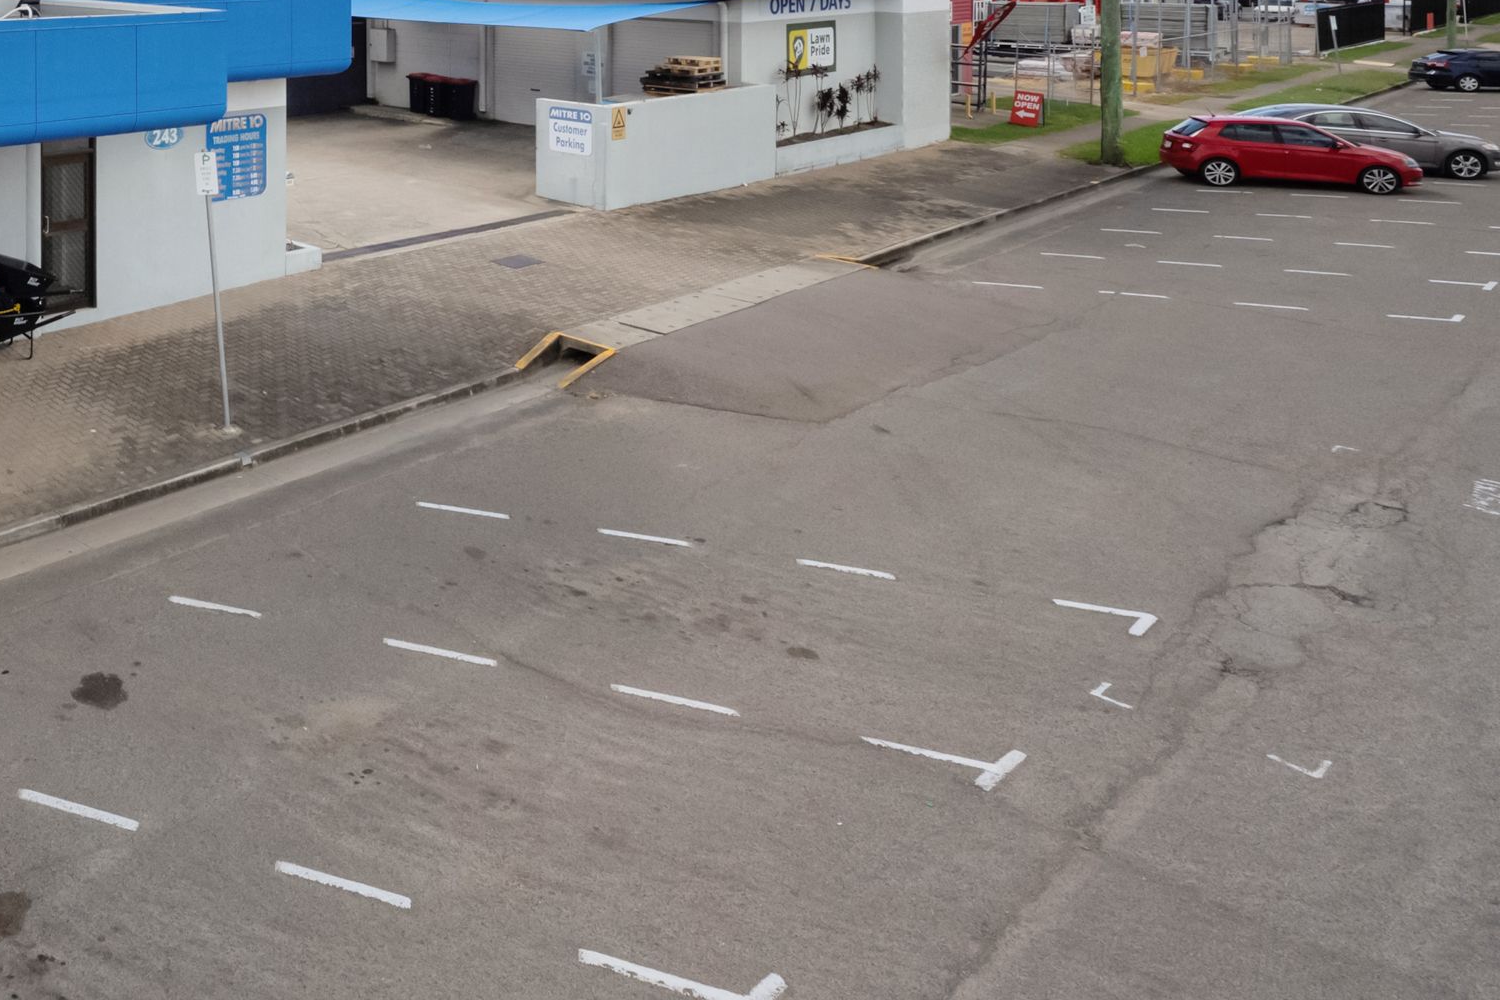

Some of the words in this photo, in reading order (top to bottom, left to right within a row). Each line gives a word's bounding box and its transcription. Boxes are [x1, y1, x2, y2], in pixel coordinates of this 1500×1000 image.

[810, 33, 831, 45] Lawn
[810, 45, 831, 57] Pride
[1016, 93, 1040, 103] NOW
[1014, 100, 1040, 110] OPEN
[550, 108, 578, 120] MITRE
[580, 111, 592, 121] 10
[210, 117, 248, 134] MITRE
[249, 115, 264, 129] 10
[553, 121, 588, 137] Customer
[152, 127, 178, 146] 243
[556, 136, 586, 153] Parking
